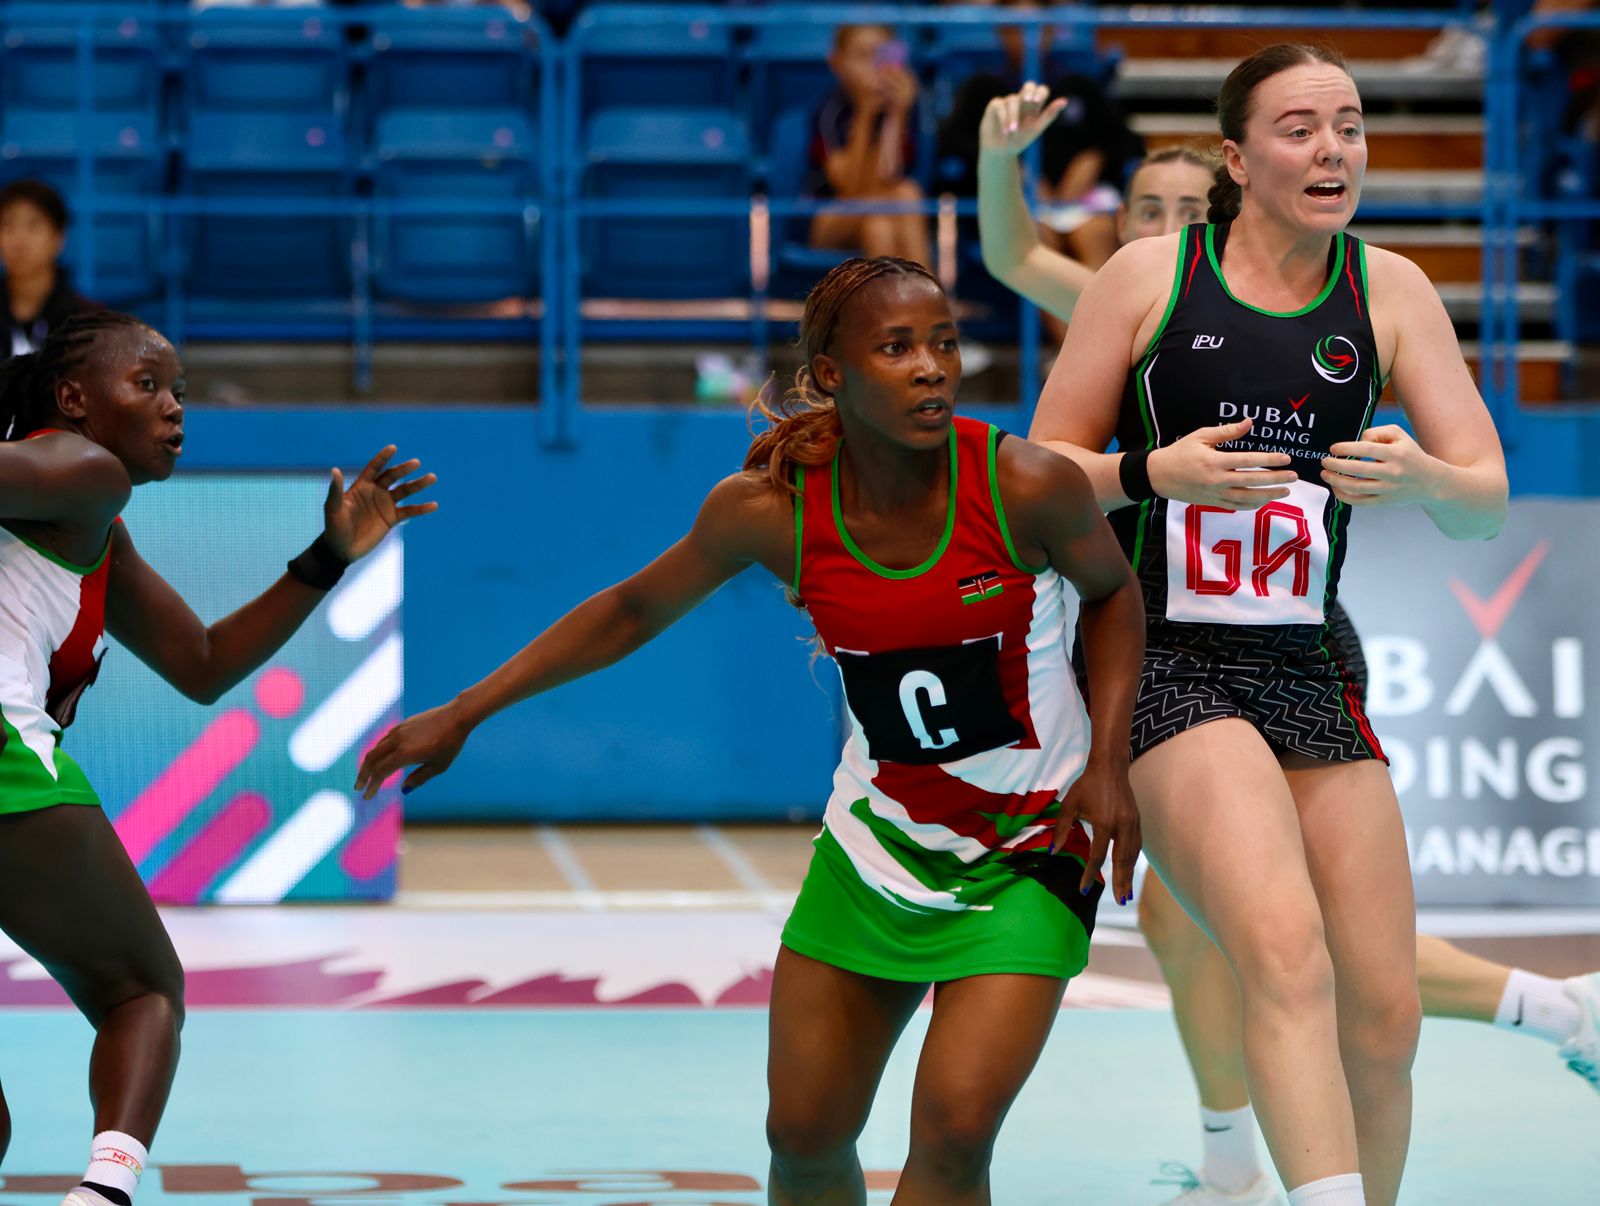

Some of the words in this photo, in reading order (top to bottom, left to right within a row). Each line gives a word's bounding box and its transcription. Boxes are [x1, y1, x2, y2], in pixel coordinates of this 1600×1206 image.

[1218, 422, 1310, 445] LDING
[1219, 401, 1315, 429] DUBAI
[898, 669, 960, 749] C
[1405, 825, 1600, 877] ANAG
